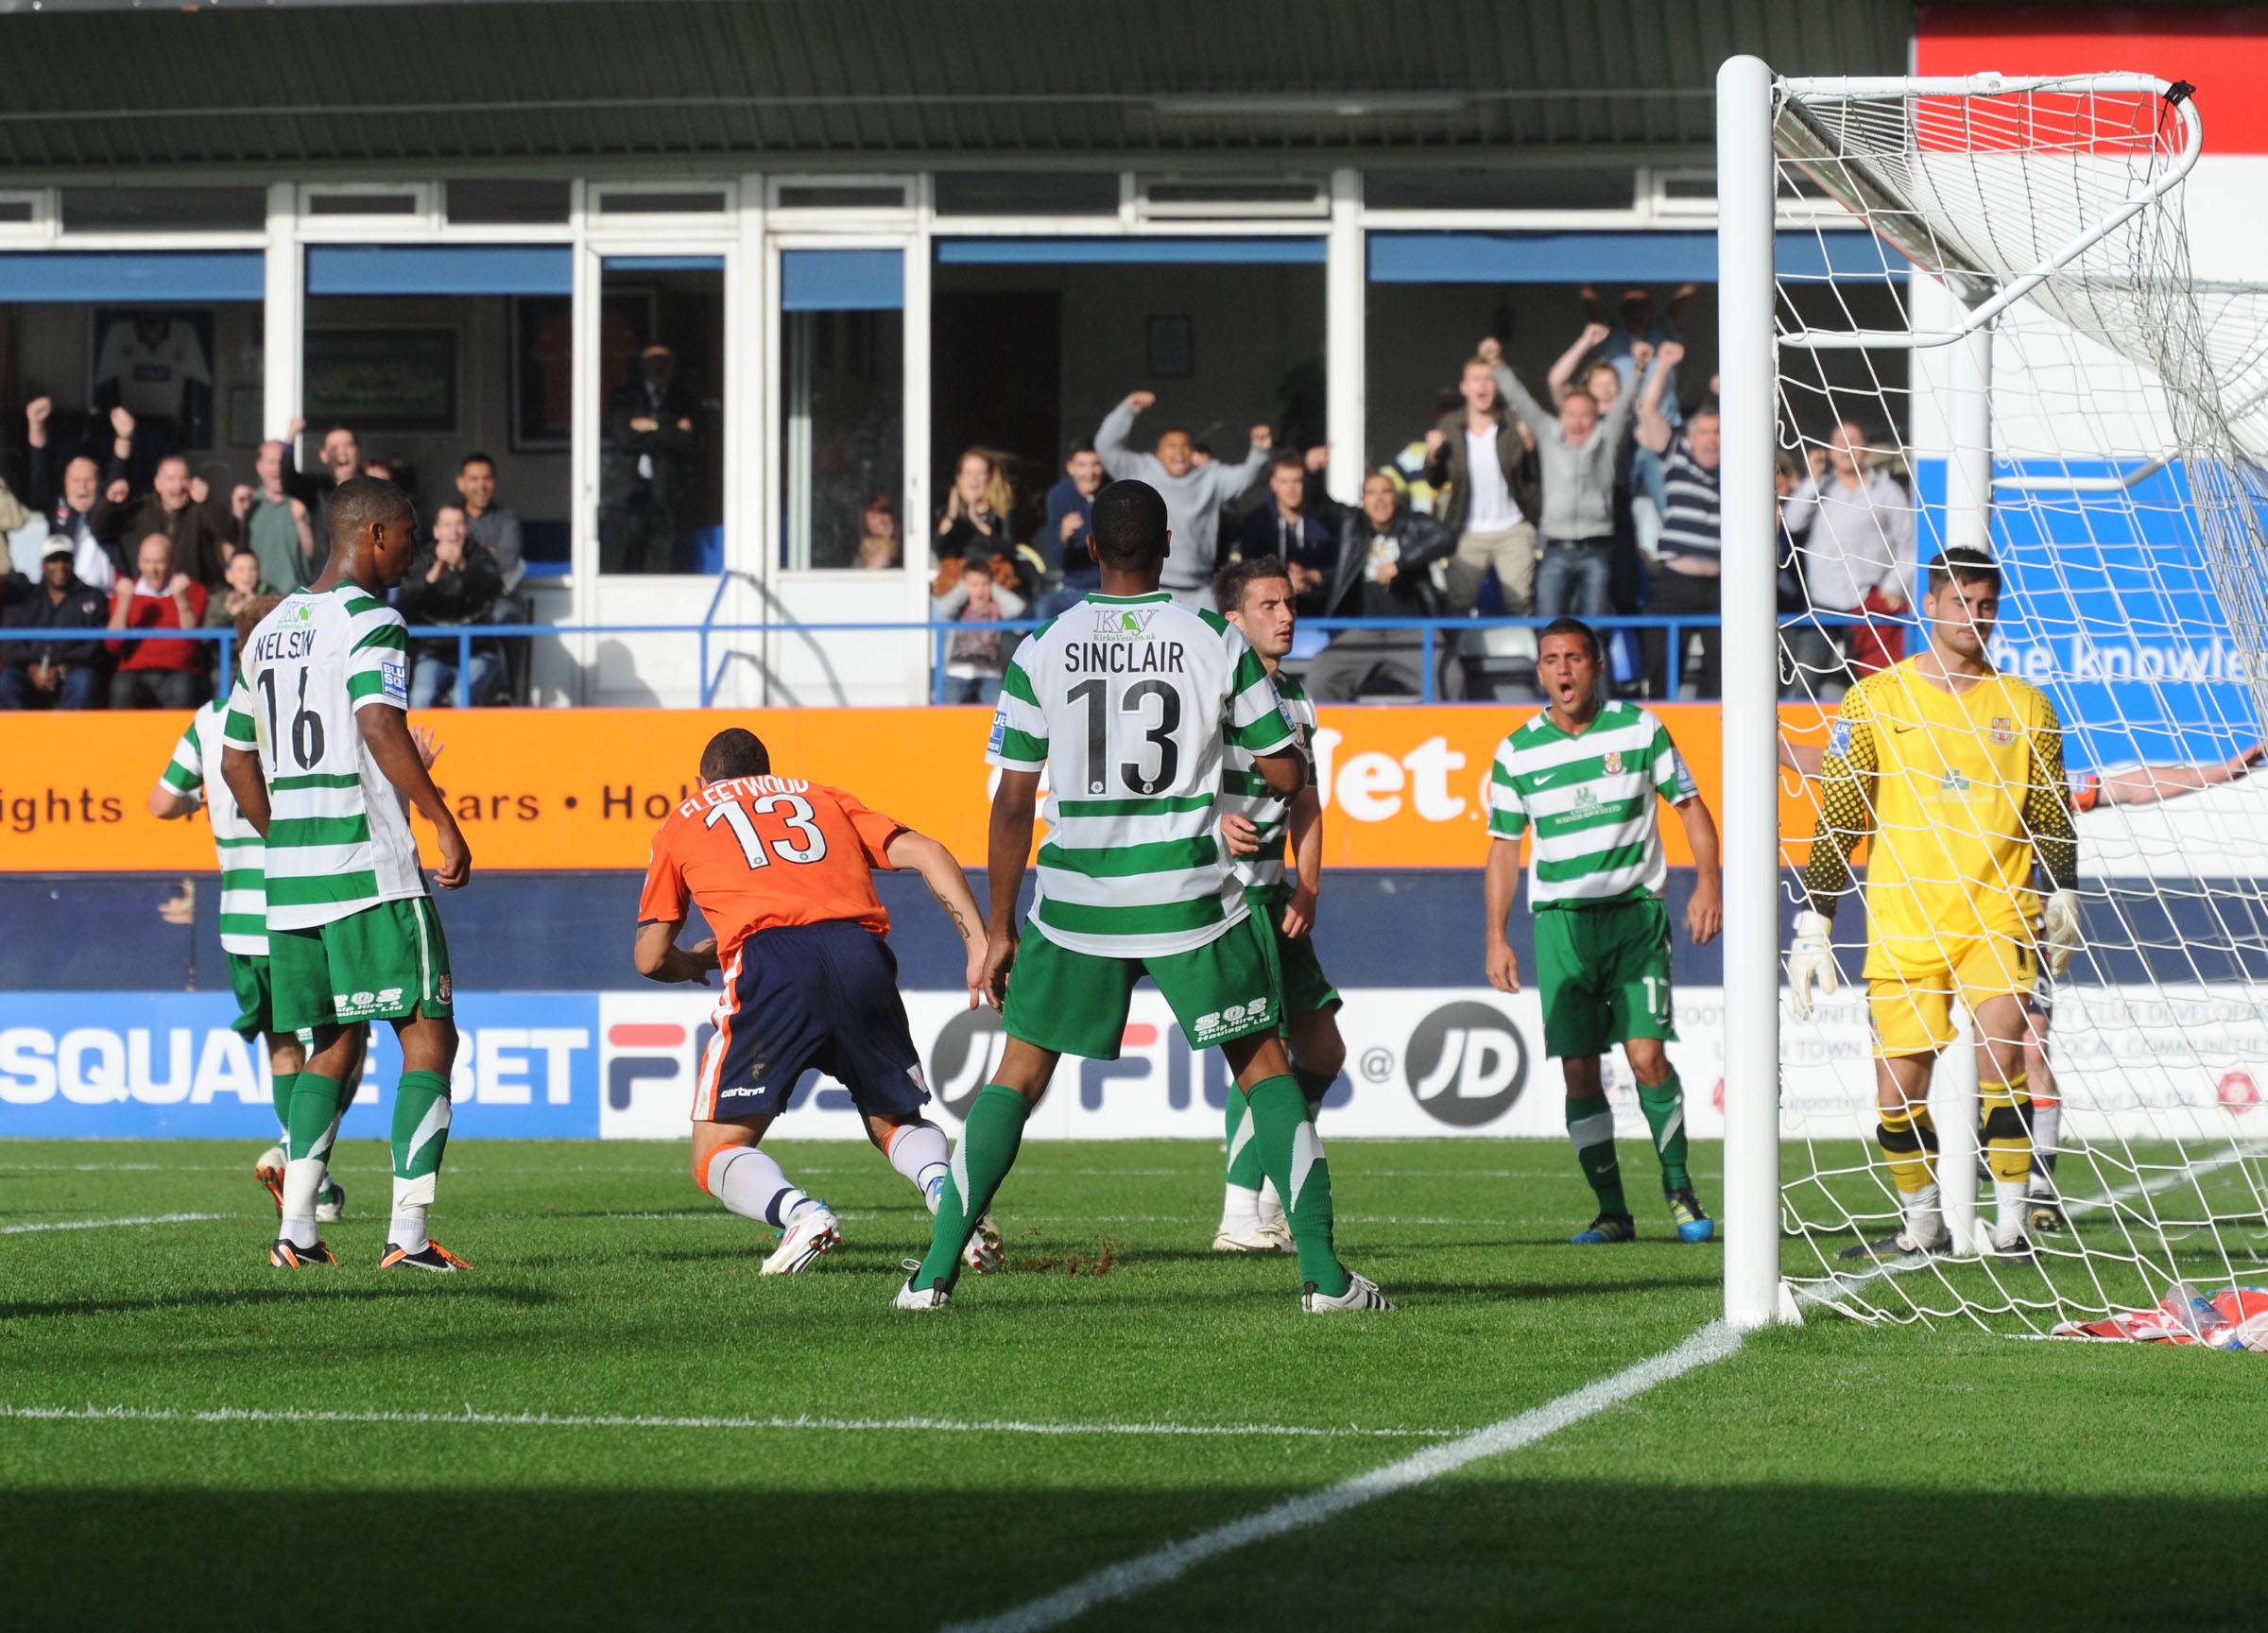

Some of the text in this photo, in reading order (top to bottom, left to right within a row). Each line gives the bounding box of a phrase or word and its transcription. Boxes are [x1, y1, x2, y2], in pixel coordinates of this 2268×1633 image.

[1065, 642, 1184, 673] SINCLAIR
[257, 665, 325, 773] 16
[1067, 679, 1180, 795] 13
[679, 775, 809, 819] FLEETWOOD
[704, 793, 828, 871] 13
[1196, 1014, 1271, 1043] Haulage Ltd
[1198, 1024, 1228, 1037] Skip
[1230, 1015, 1255, 1027] Hire
[1360, 1047, 1395, 1084] @
[1418, 1027, 1521, 1101] JD
